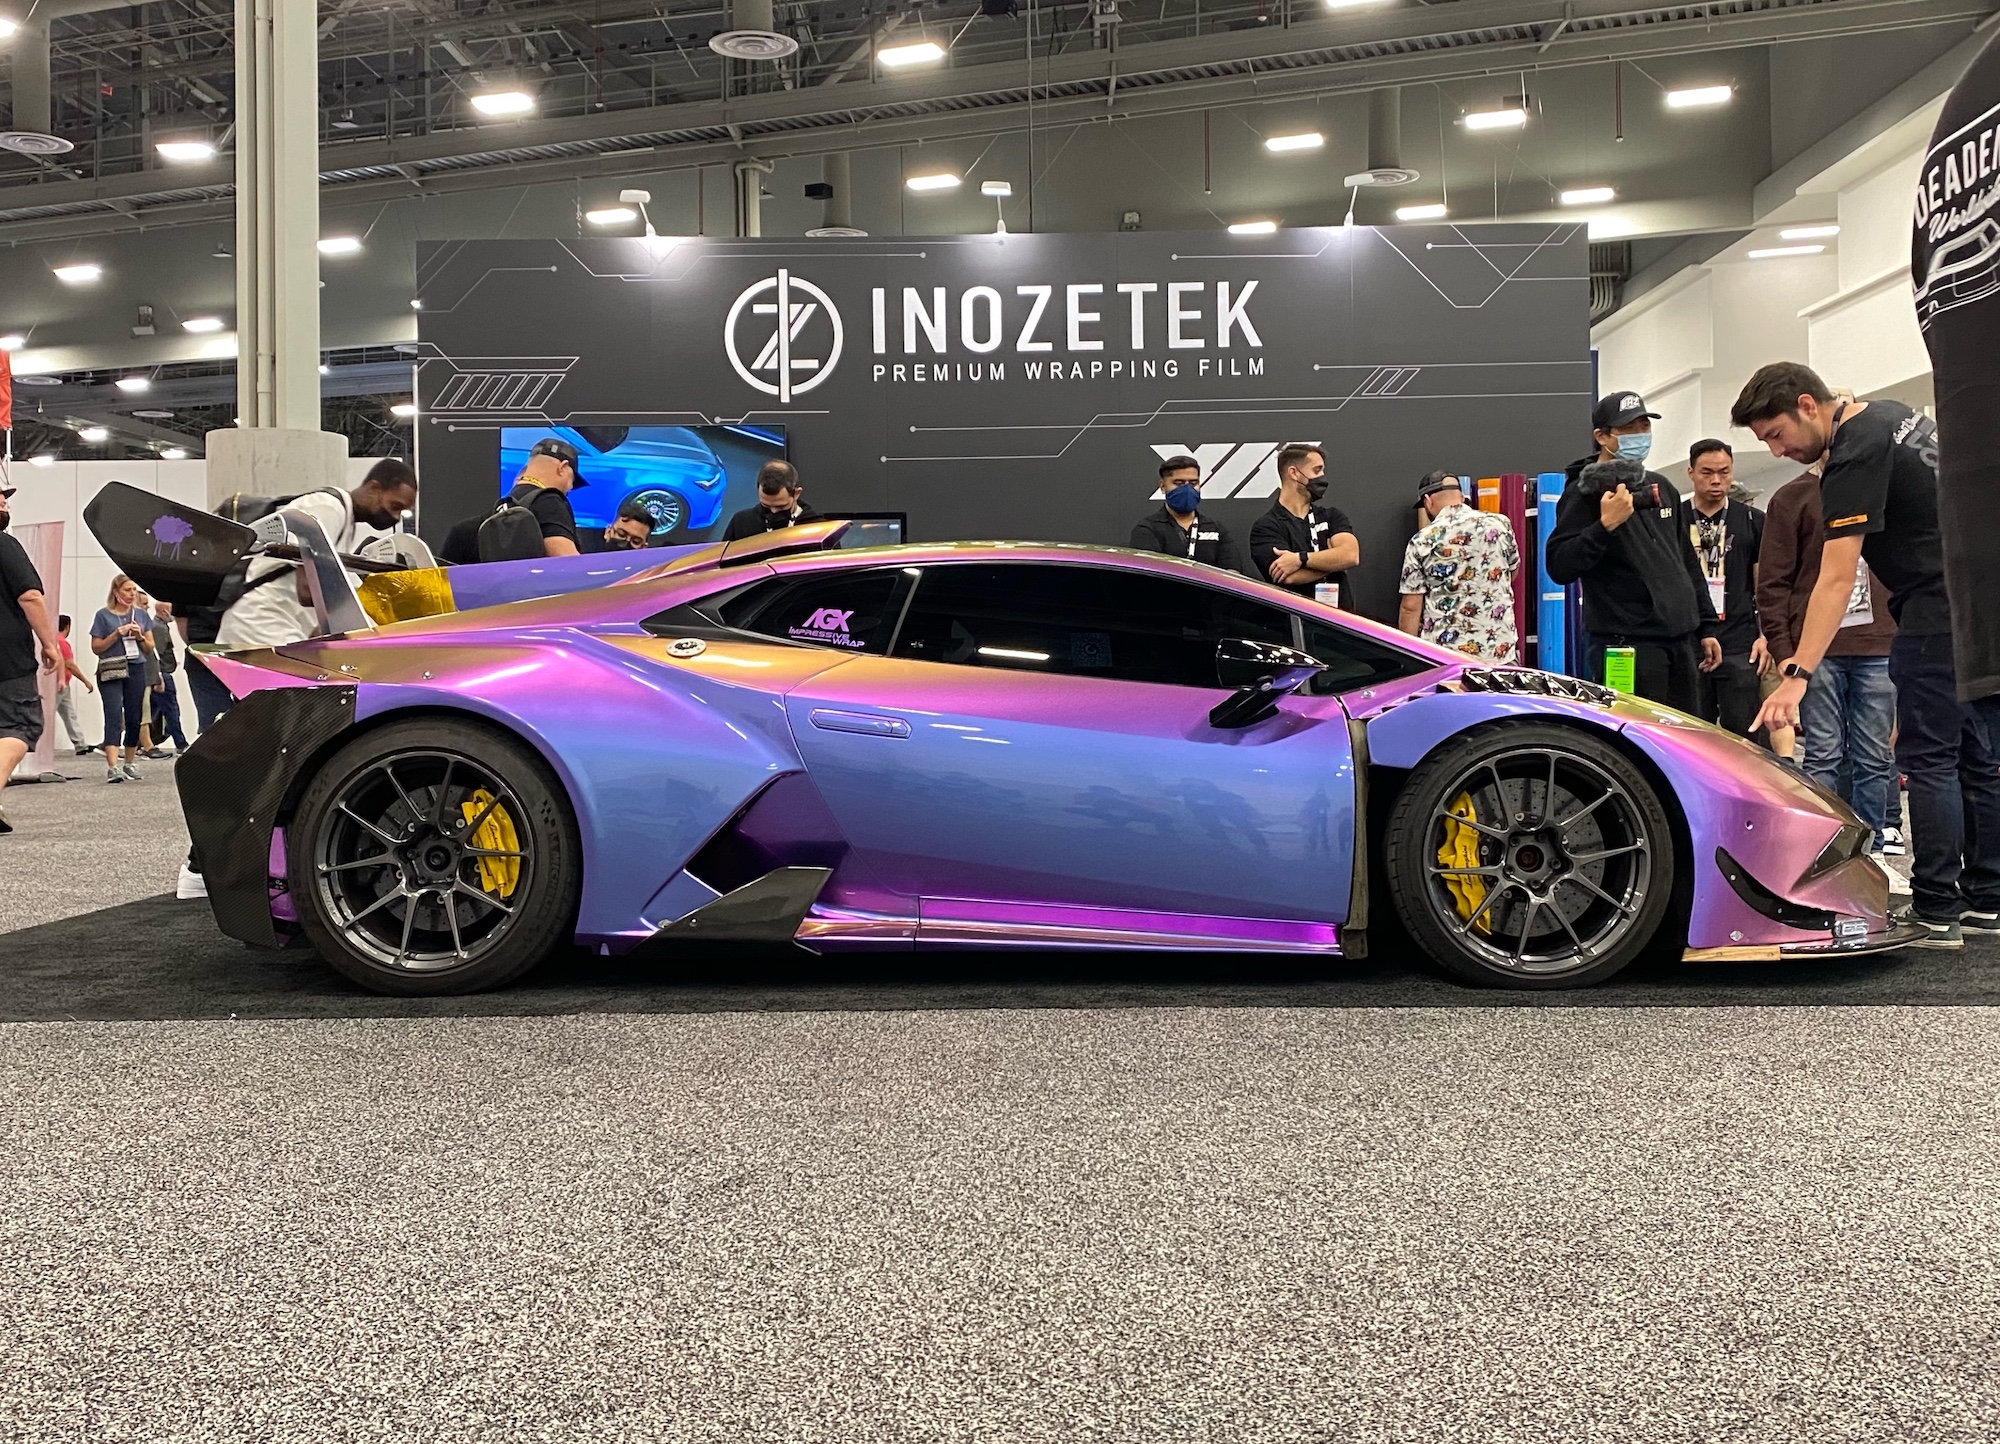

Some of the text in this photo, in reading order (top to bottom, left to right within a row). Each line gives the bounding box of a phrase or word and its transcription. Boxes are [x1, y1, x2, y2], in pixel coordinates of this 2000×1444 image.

[872, 281, 1263, 354] INOZETEK
[873, 357, 1264, 382] PREMIUM WRAPPING FILM
[832, 638, 865, 648] WRAP
